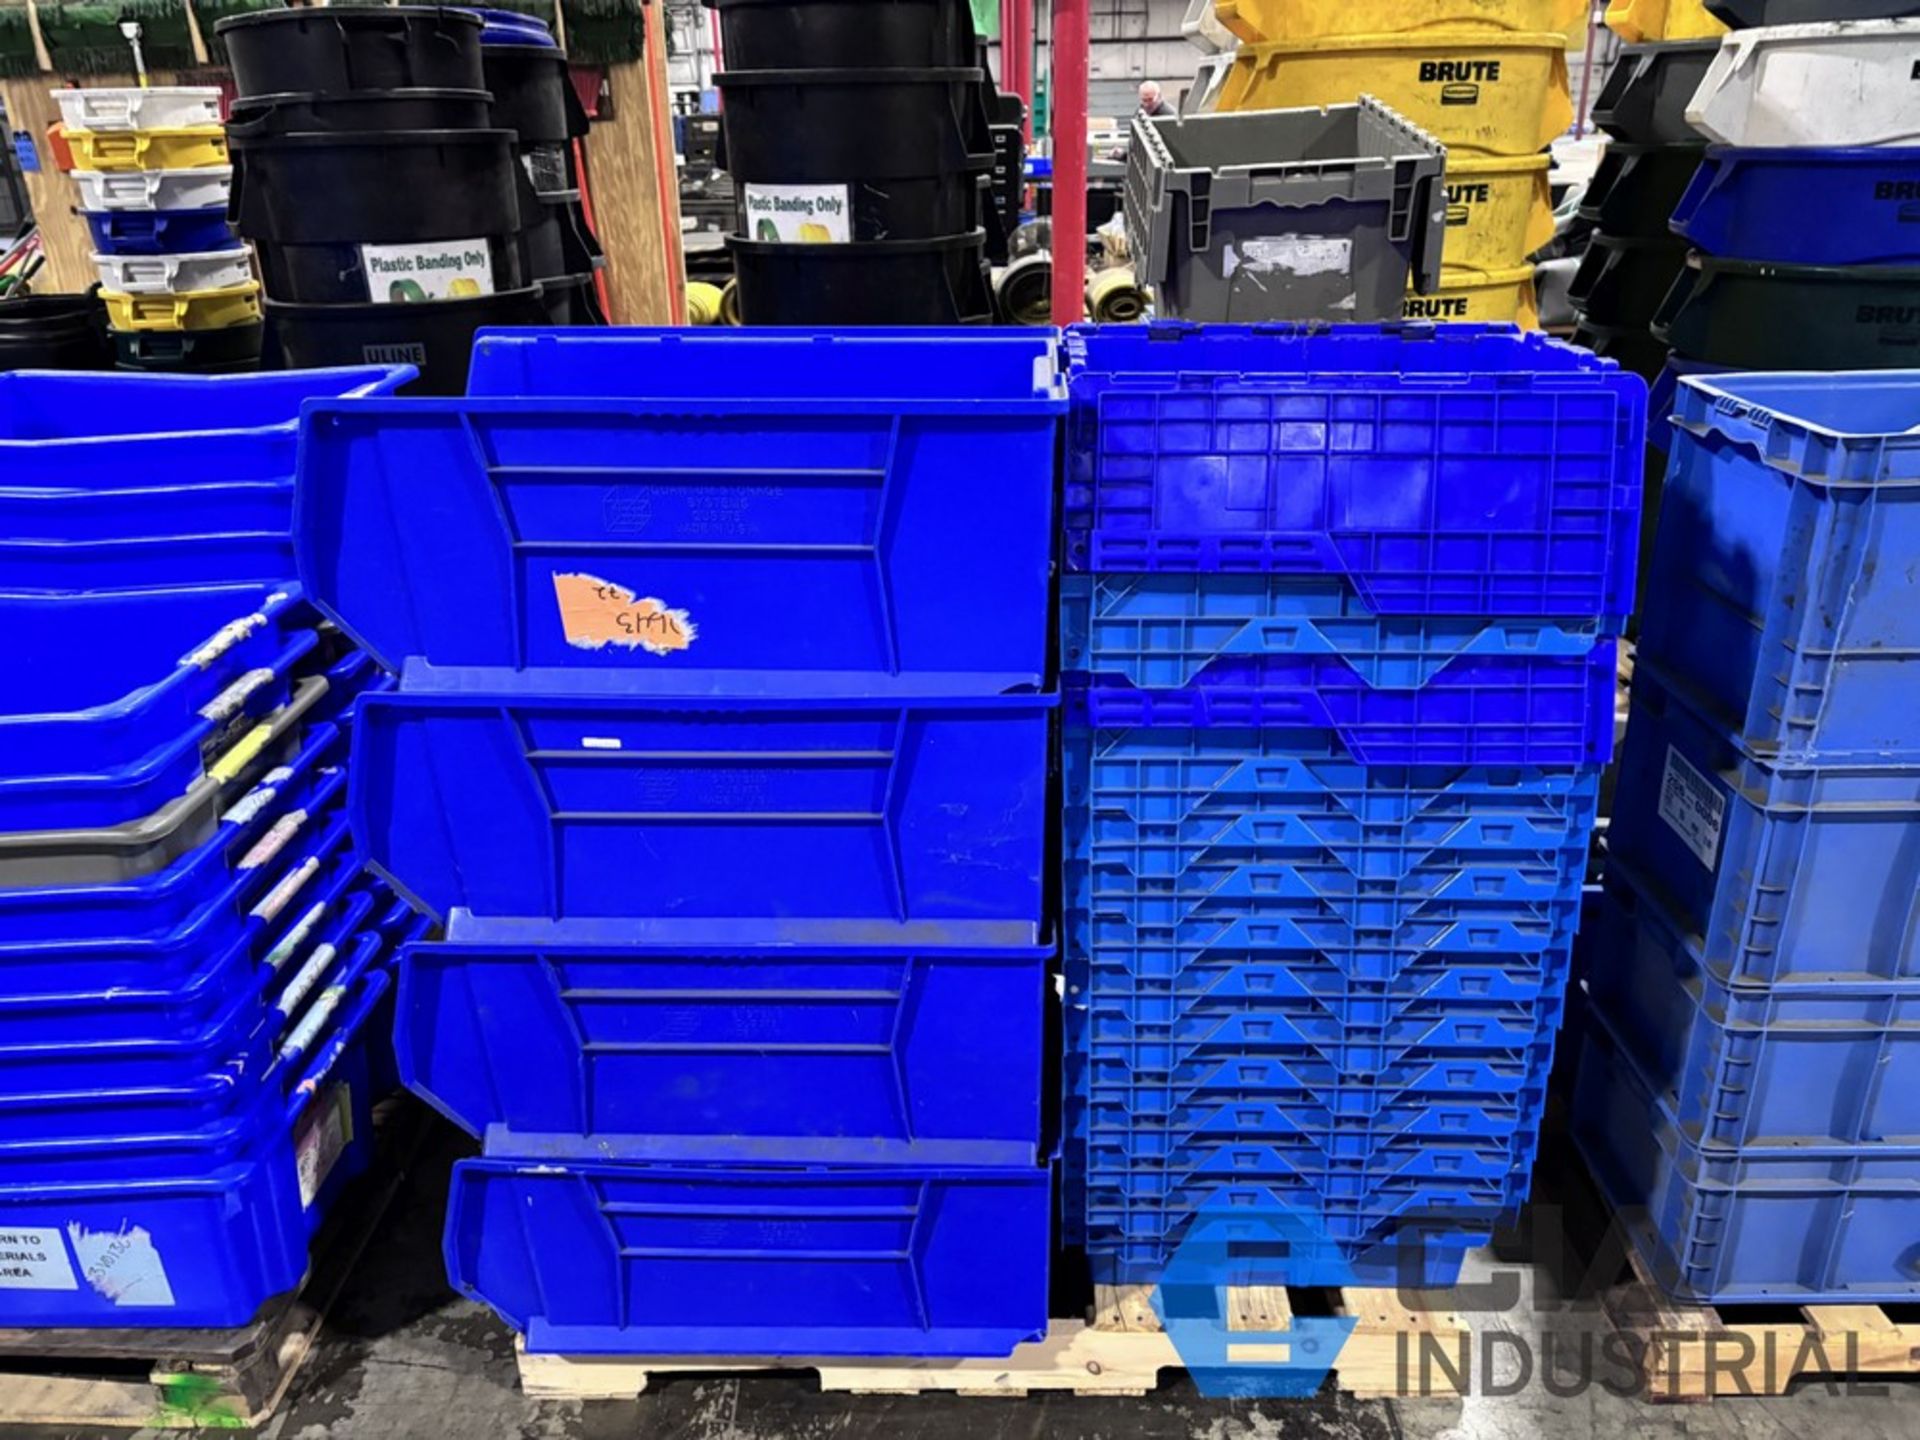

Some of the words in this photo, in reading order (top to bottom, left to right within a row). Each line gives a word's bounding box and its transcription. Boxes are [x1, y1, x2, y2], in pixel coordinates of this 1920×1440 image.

[1418, 60, 1500, 82] BRUTE
[1447, 183, 1489, 204] UTE
[1873, 180, 1920, 201] BR
[773, 194, 814, 216] Banding
[816, 195, 842, 216] Only
[370, 256, 413, 273] Plastic
[415, 252, 463, 272] Banding
[463, 250, 486, 269] Only
[365, 346, 424, 364] ULINE
[20, 1234, 42, 1246] TO
[0, 1267, 34, 1278] REA
